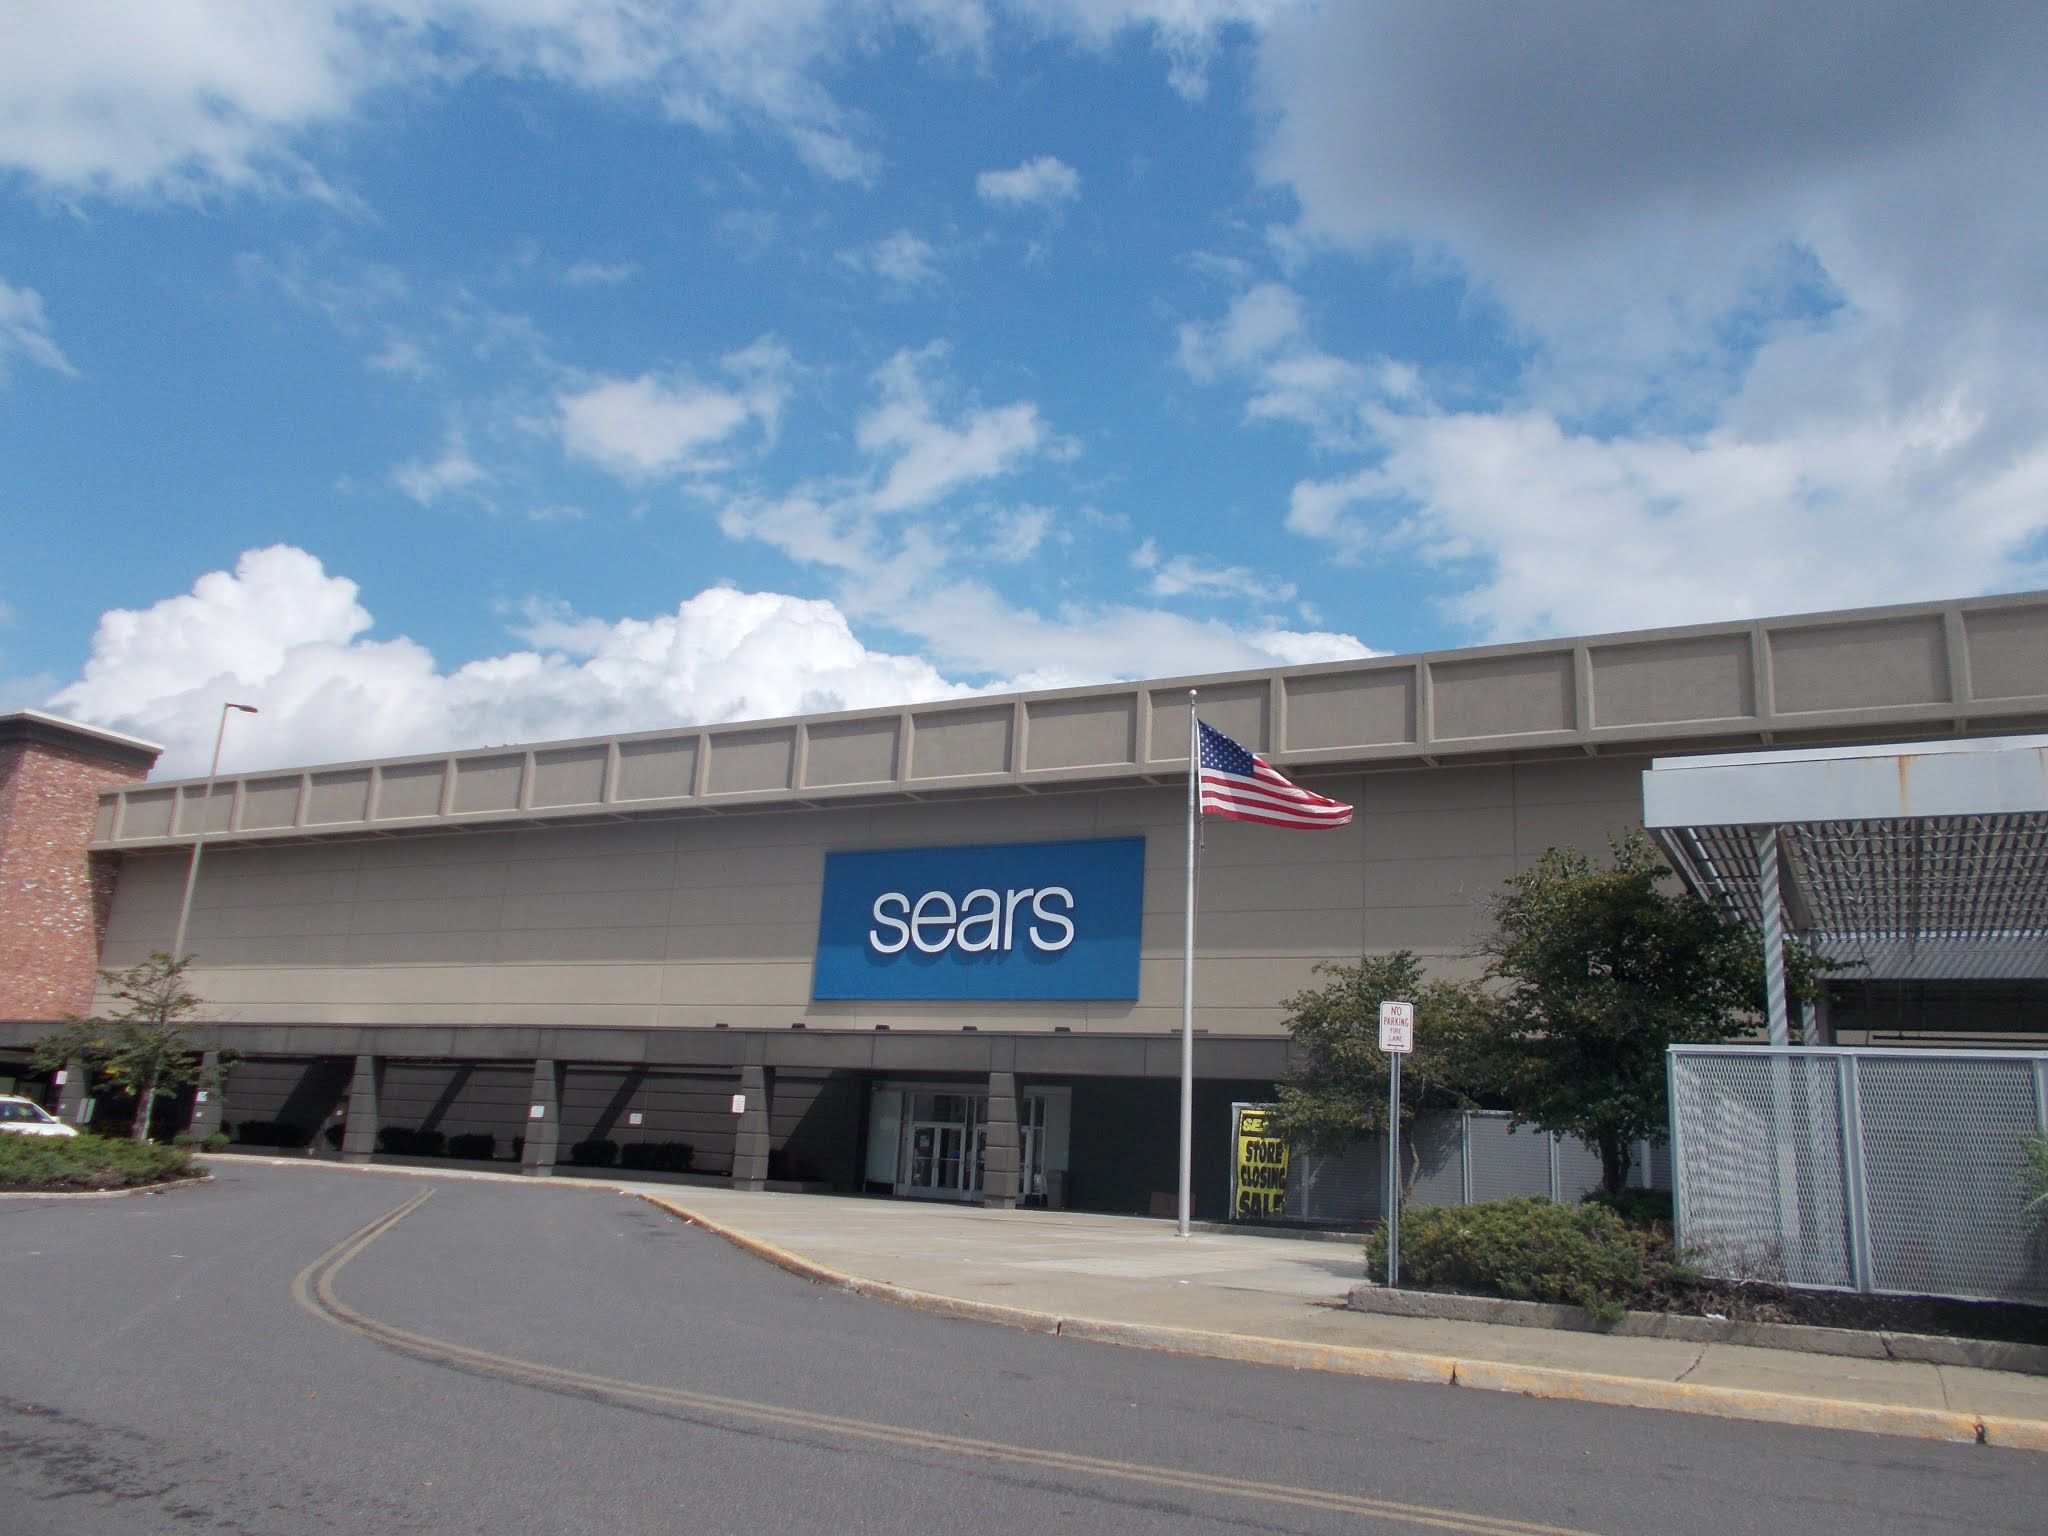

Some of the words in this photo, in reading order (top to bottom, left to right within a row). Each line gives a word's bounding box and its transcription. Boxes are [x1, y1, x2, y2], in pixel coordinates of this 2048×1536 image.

[870, 886, 1074, 953] sears
[1383, 1016, 1409, 1027] PARKING
[1391, 1006, 1402, 1016] NO
[1245, 1140, 1284, 1163] STORE
[1241, 1165, 1286, 1188] CLOSING
[1239, 1191, 1286, 1217] SALE
